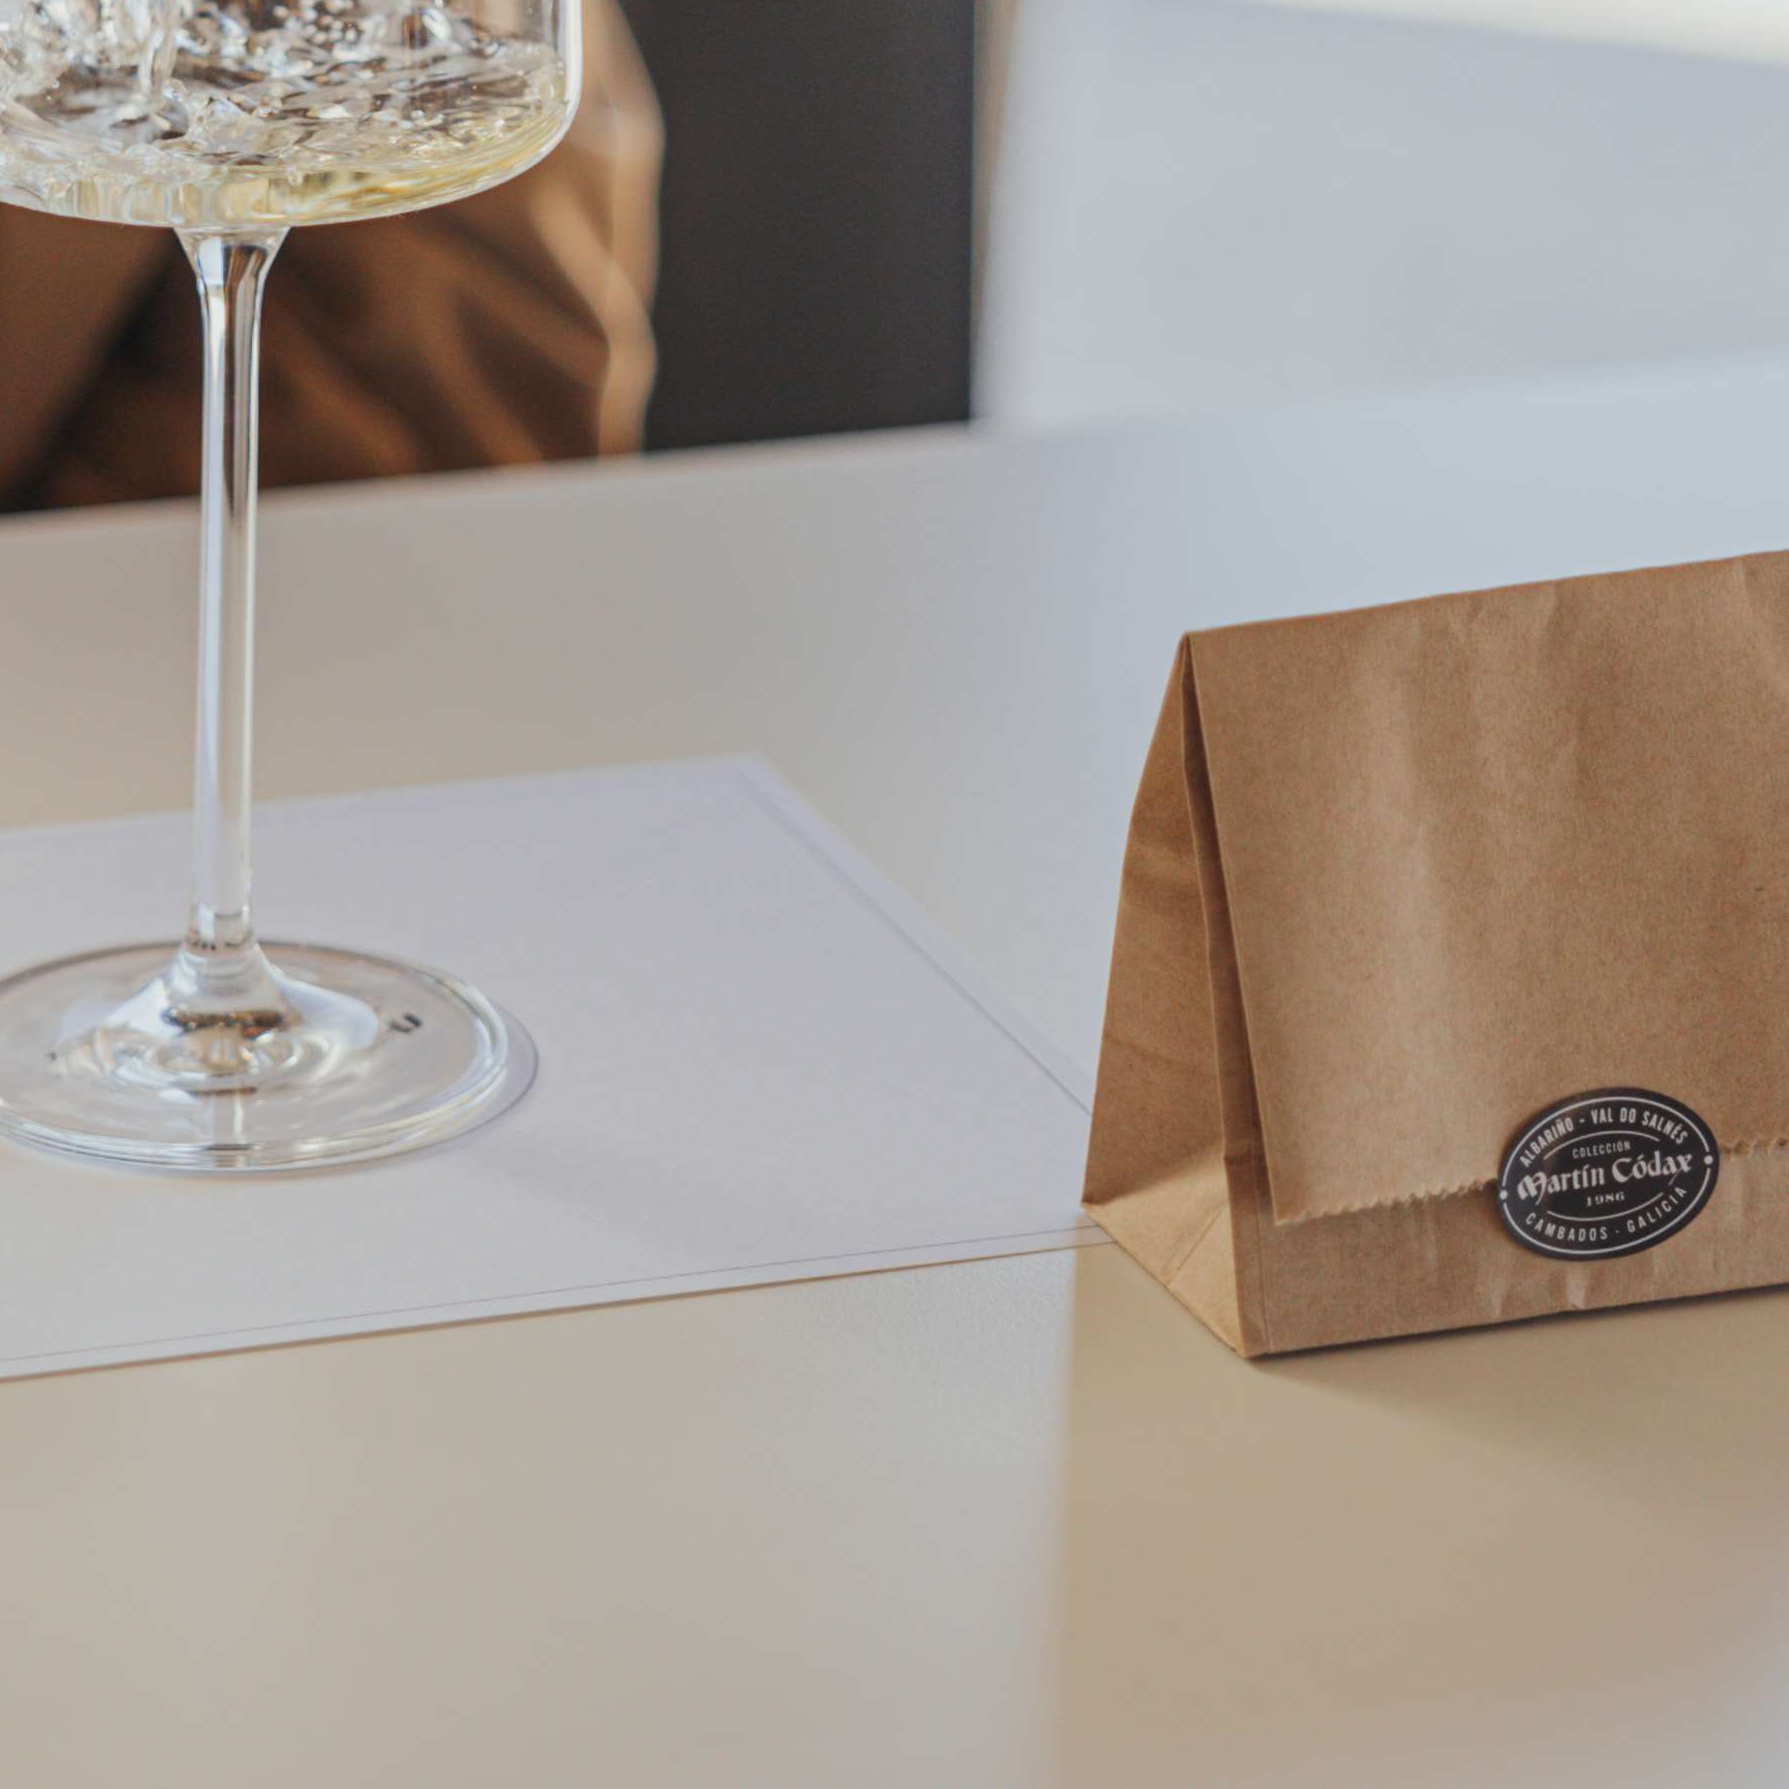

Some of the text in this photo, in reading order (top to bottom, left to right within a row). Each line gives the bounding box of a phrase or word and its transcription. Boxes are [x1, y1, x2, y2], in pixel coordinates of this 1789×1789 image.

[1519, 1107, 1689, 1169] ALBARIÑO VAL DO SALNÉS
[1572, 1139, 1631, 1160] COLECCIÓN
[1516, 1149, 1693, 1206] Martín Códax
[1586, 1191, 1626, 1208] 1986
[1525, 1186, 1688, 1242] CAMBADOS GALICIA
